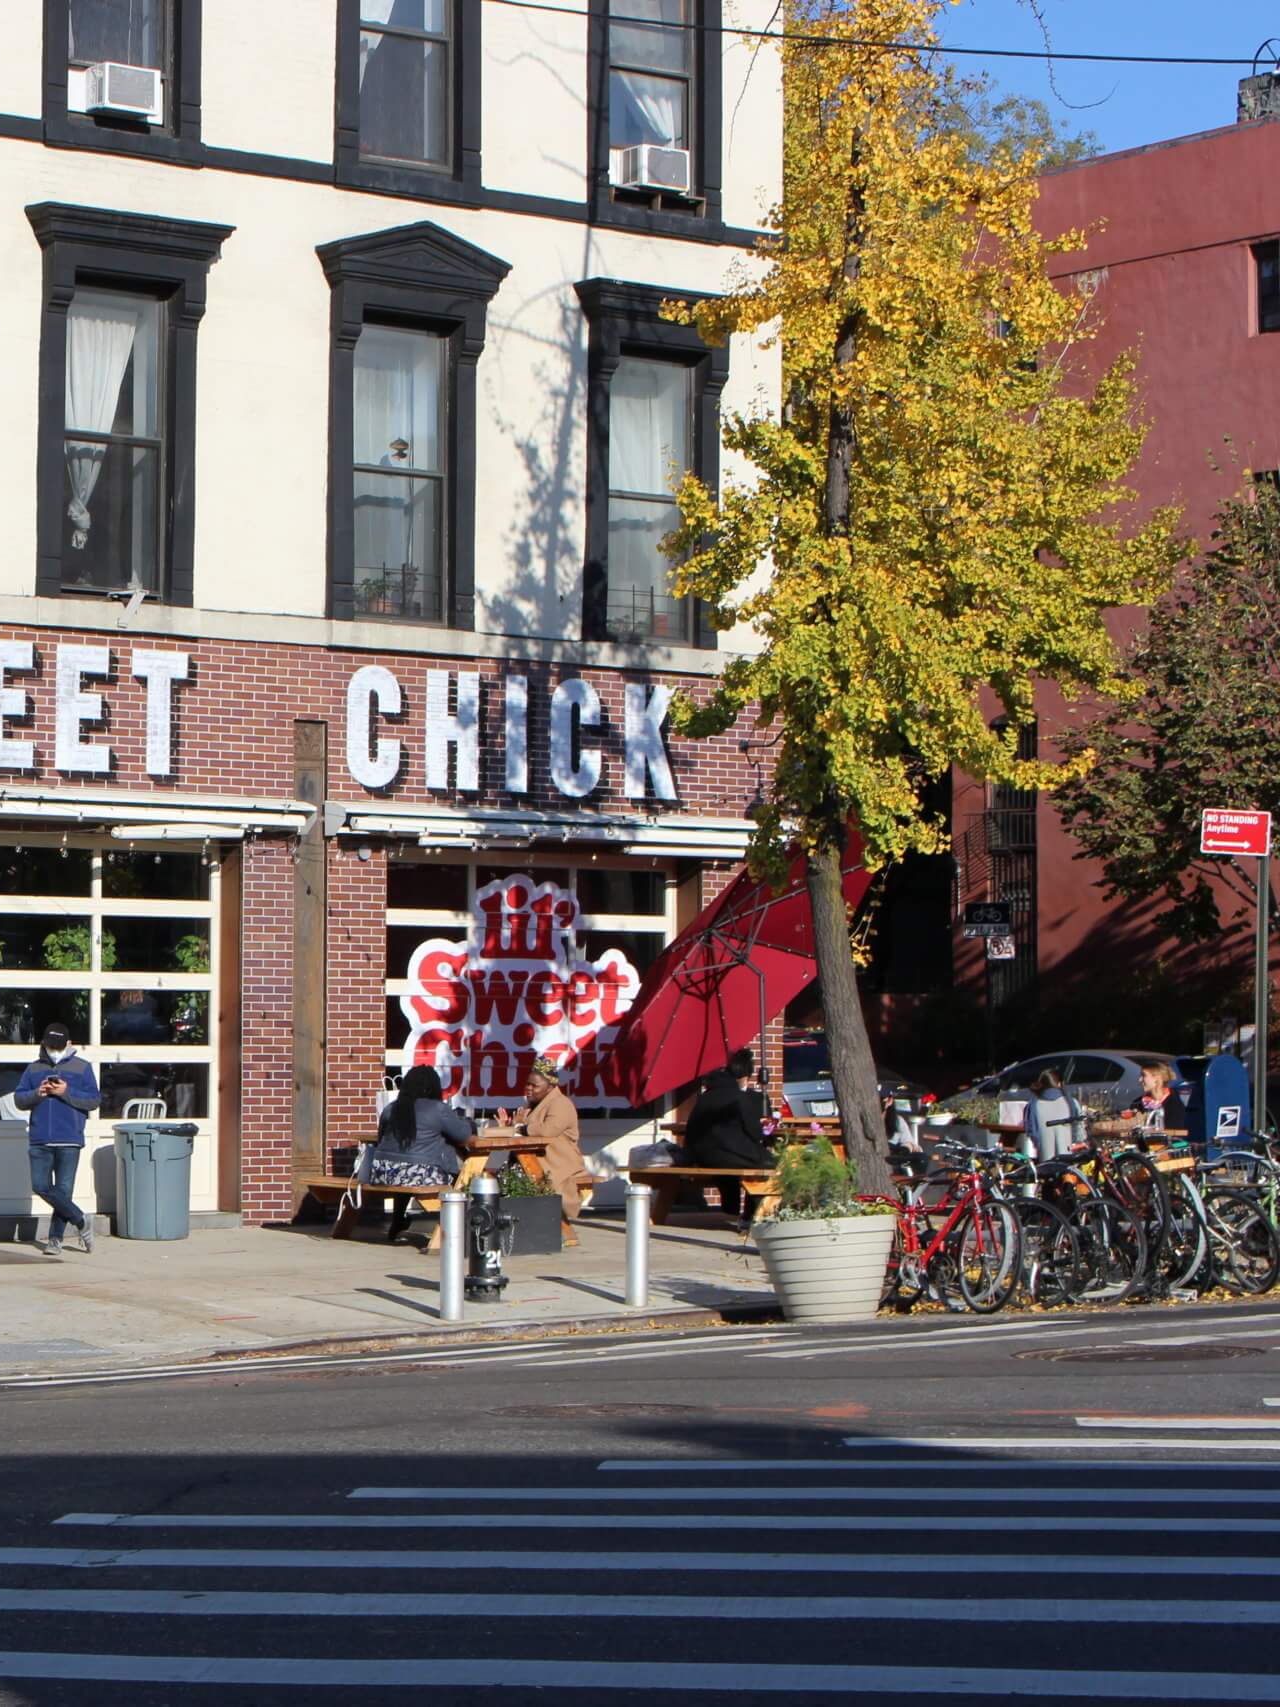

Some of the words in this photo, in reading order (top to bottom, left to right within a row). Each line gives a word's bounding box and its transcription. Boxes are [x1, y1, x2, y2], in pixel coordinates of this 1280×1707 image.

[345, 664, 678, 802] CHICK
[1206, 814, 1218, 822] NO
[1220, 815, 1258, 824] STANDING
[1206, 824, 1239, 834] Anytime
[410, 950, 632, 1028] Sweet
